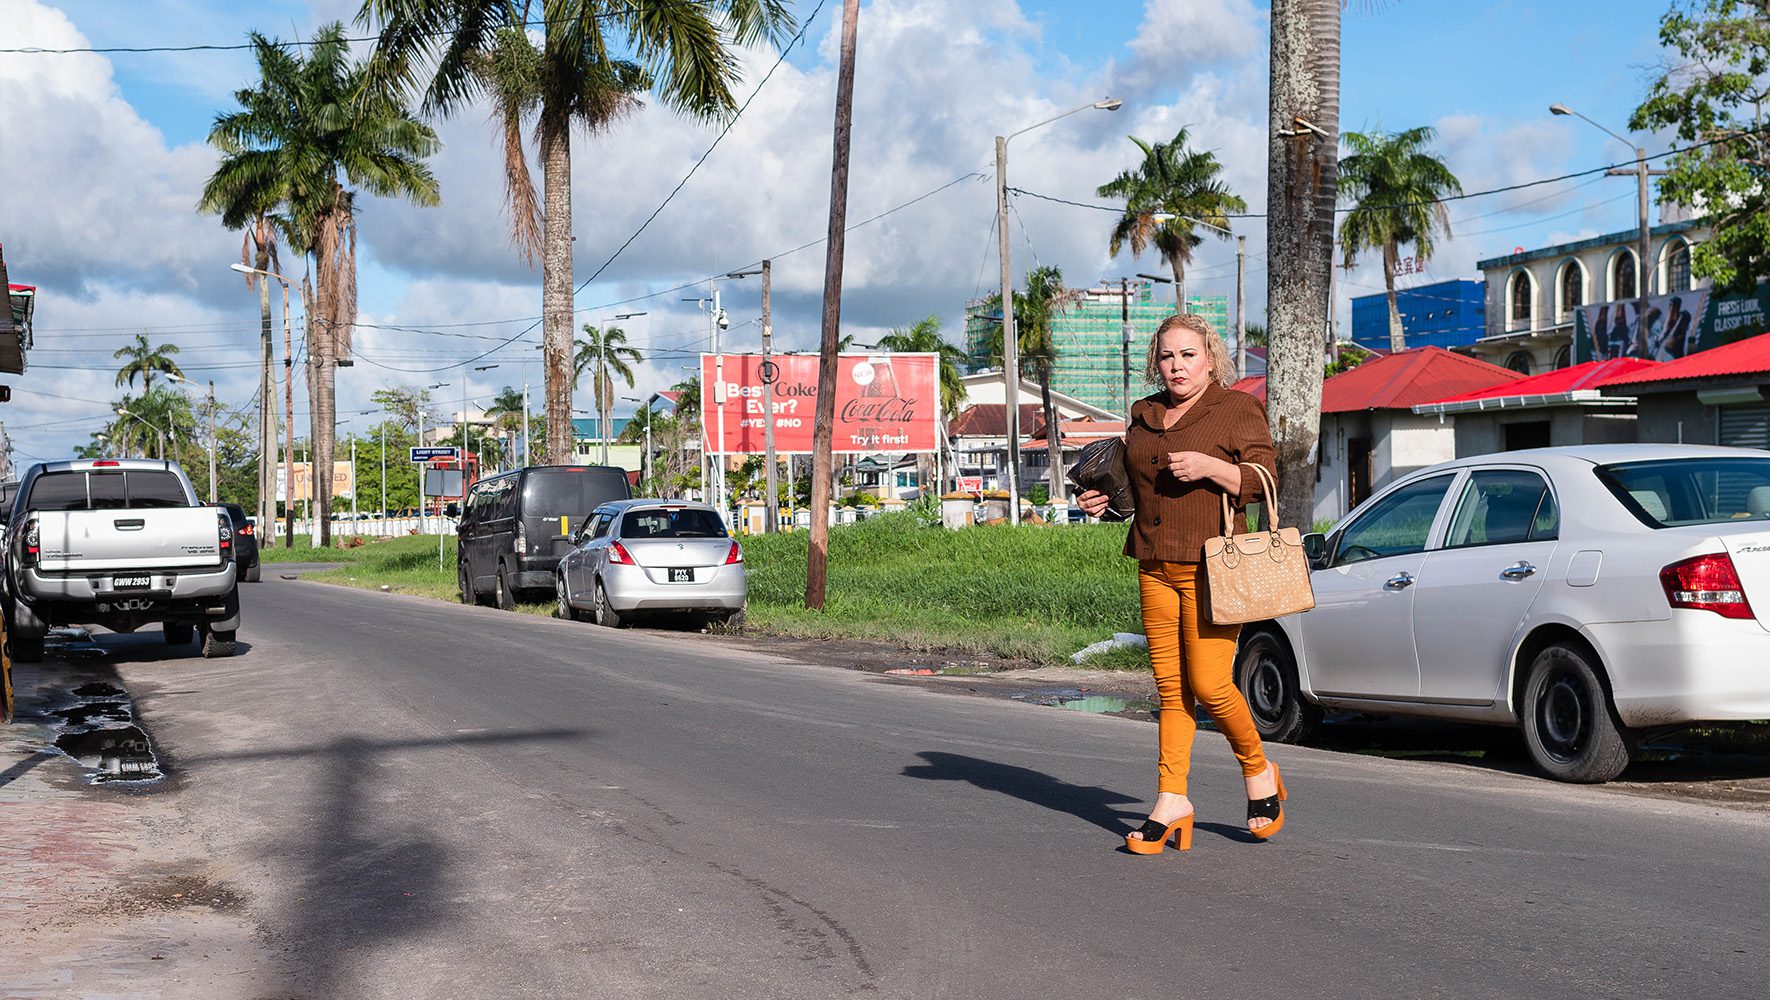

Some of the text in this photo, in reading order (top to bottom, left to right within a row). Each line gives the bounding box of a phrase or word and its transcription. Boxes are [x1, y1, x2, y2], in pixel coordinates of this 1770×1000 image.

[853, 370, 872, 378] NEW
[727, 381, 817, 397] Bes Coke
[841, 398, 918, 424] Coca-Cola
[740, 418, 802, 428] #YE #NO
[850, 434, 909, 446] Try it first!
[114, 577, 150, 587] GWW 2953
